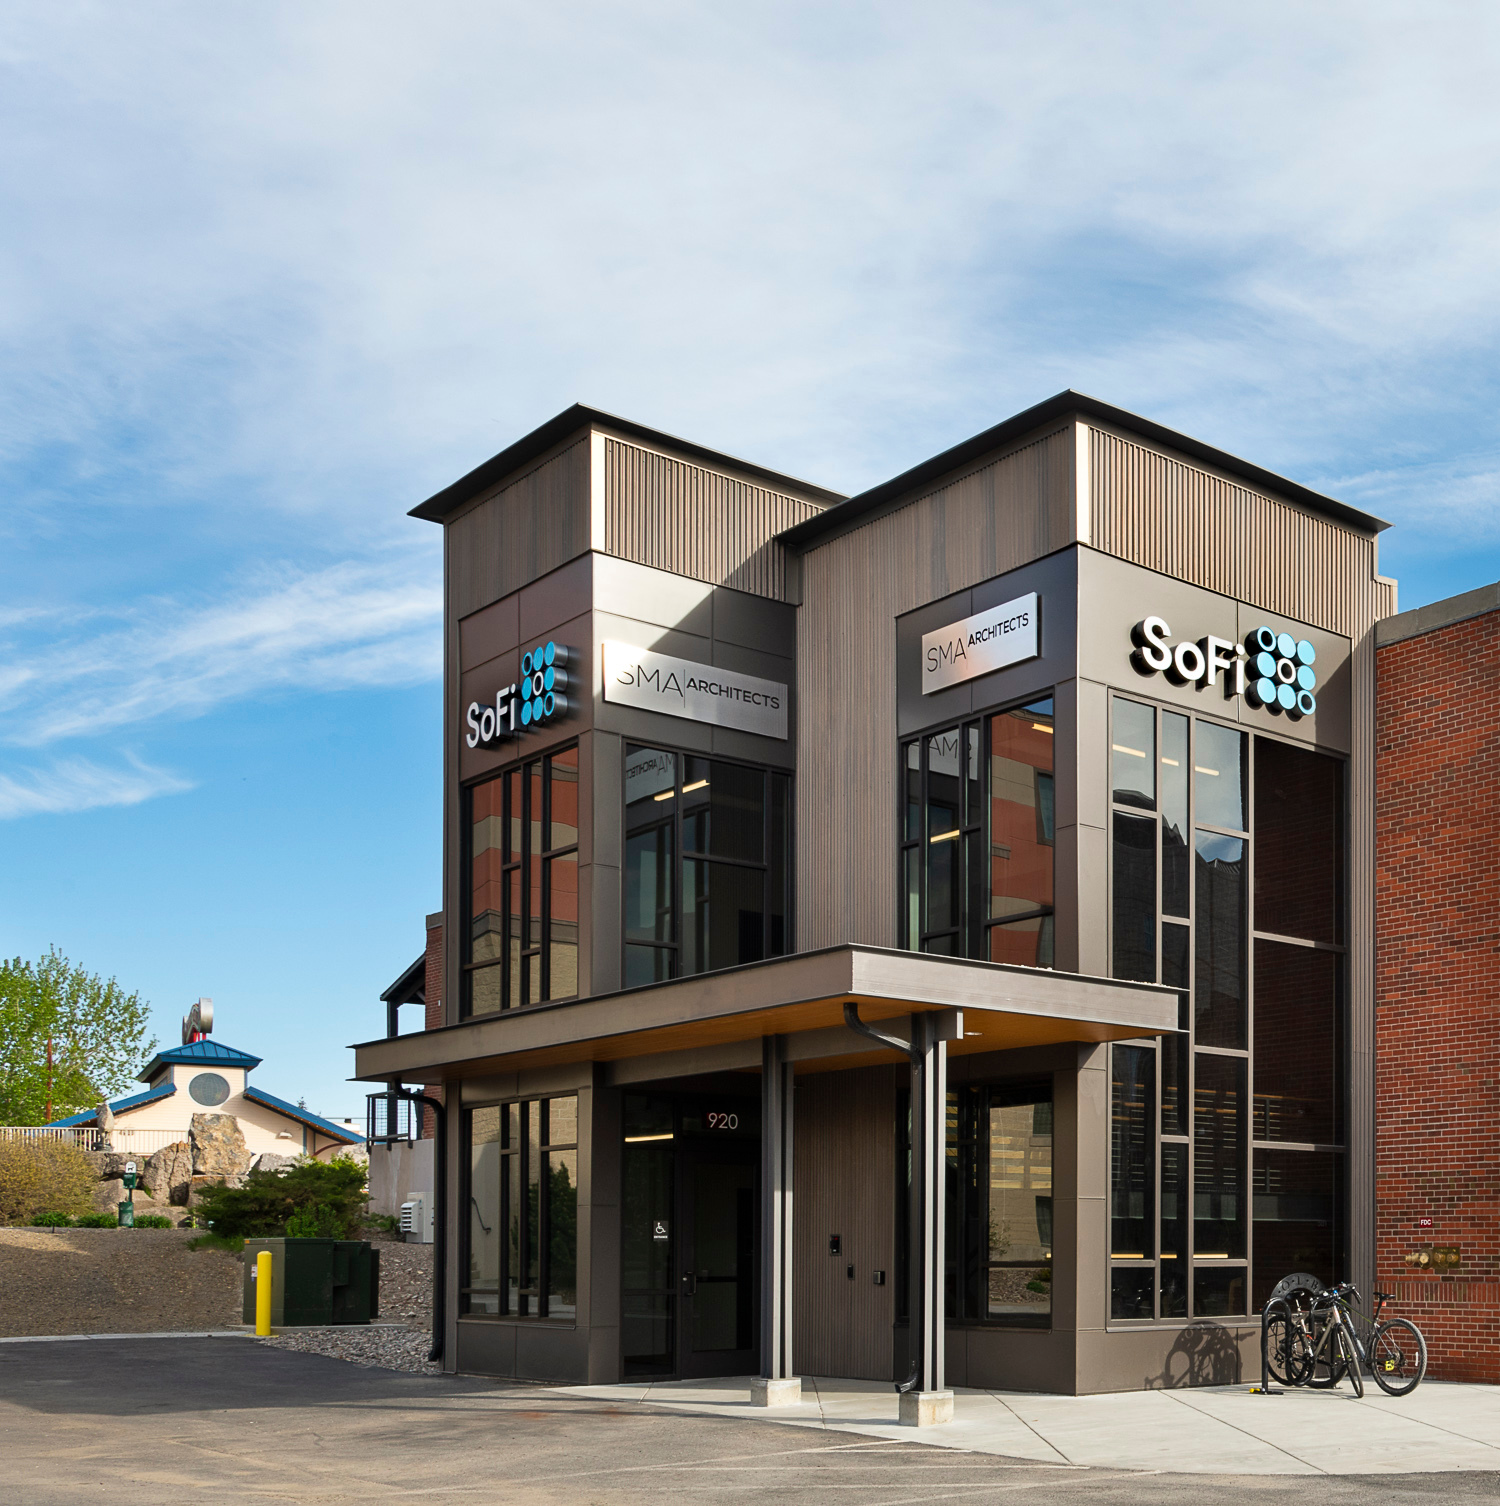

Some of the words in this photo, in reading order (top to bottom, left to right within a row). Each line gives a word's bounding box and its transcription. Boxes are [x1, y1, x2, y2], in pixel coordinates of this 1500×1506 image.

[926, 637, 967, 672] SMA
[967, 612, 1029, 648] ARCHITECTS
[1142, 615, 1245, 695] SoFi
[466, 683, 516, 748] SoFi
[616, 664, 684, 698] SMA
[686, 677, 780, 709] ARCHITECTS
[708, 1112, 739, 1130] 920
